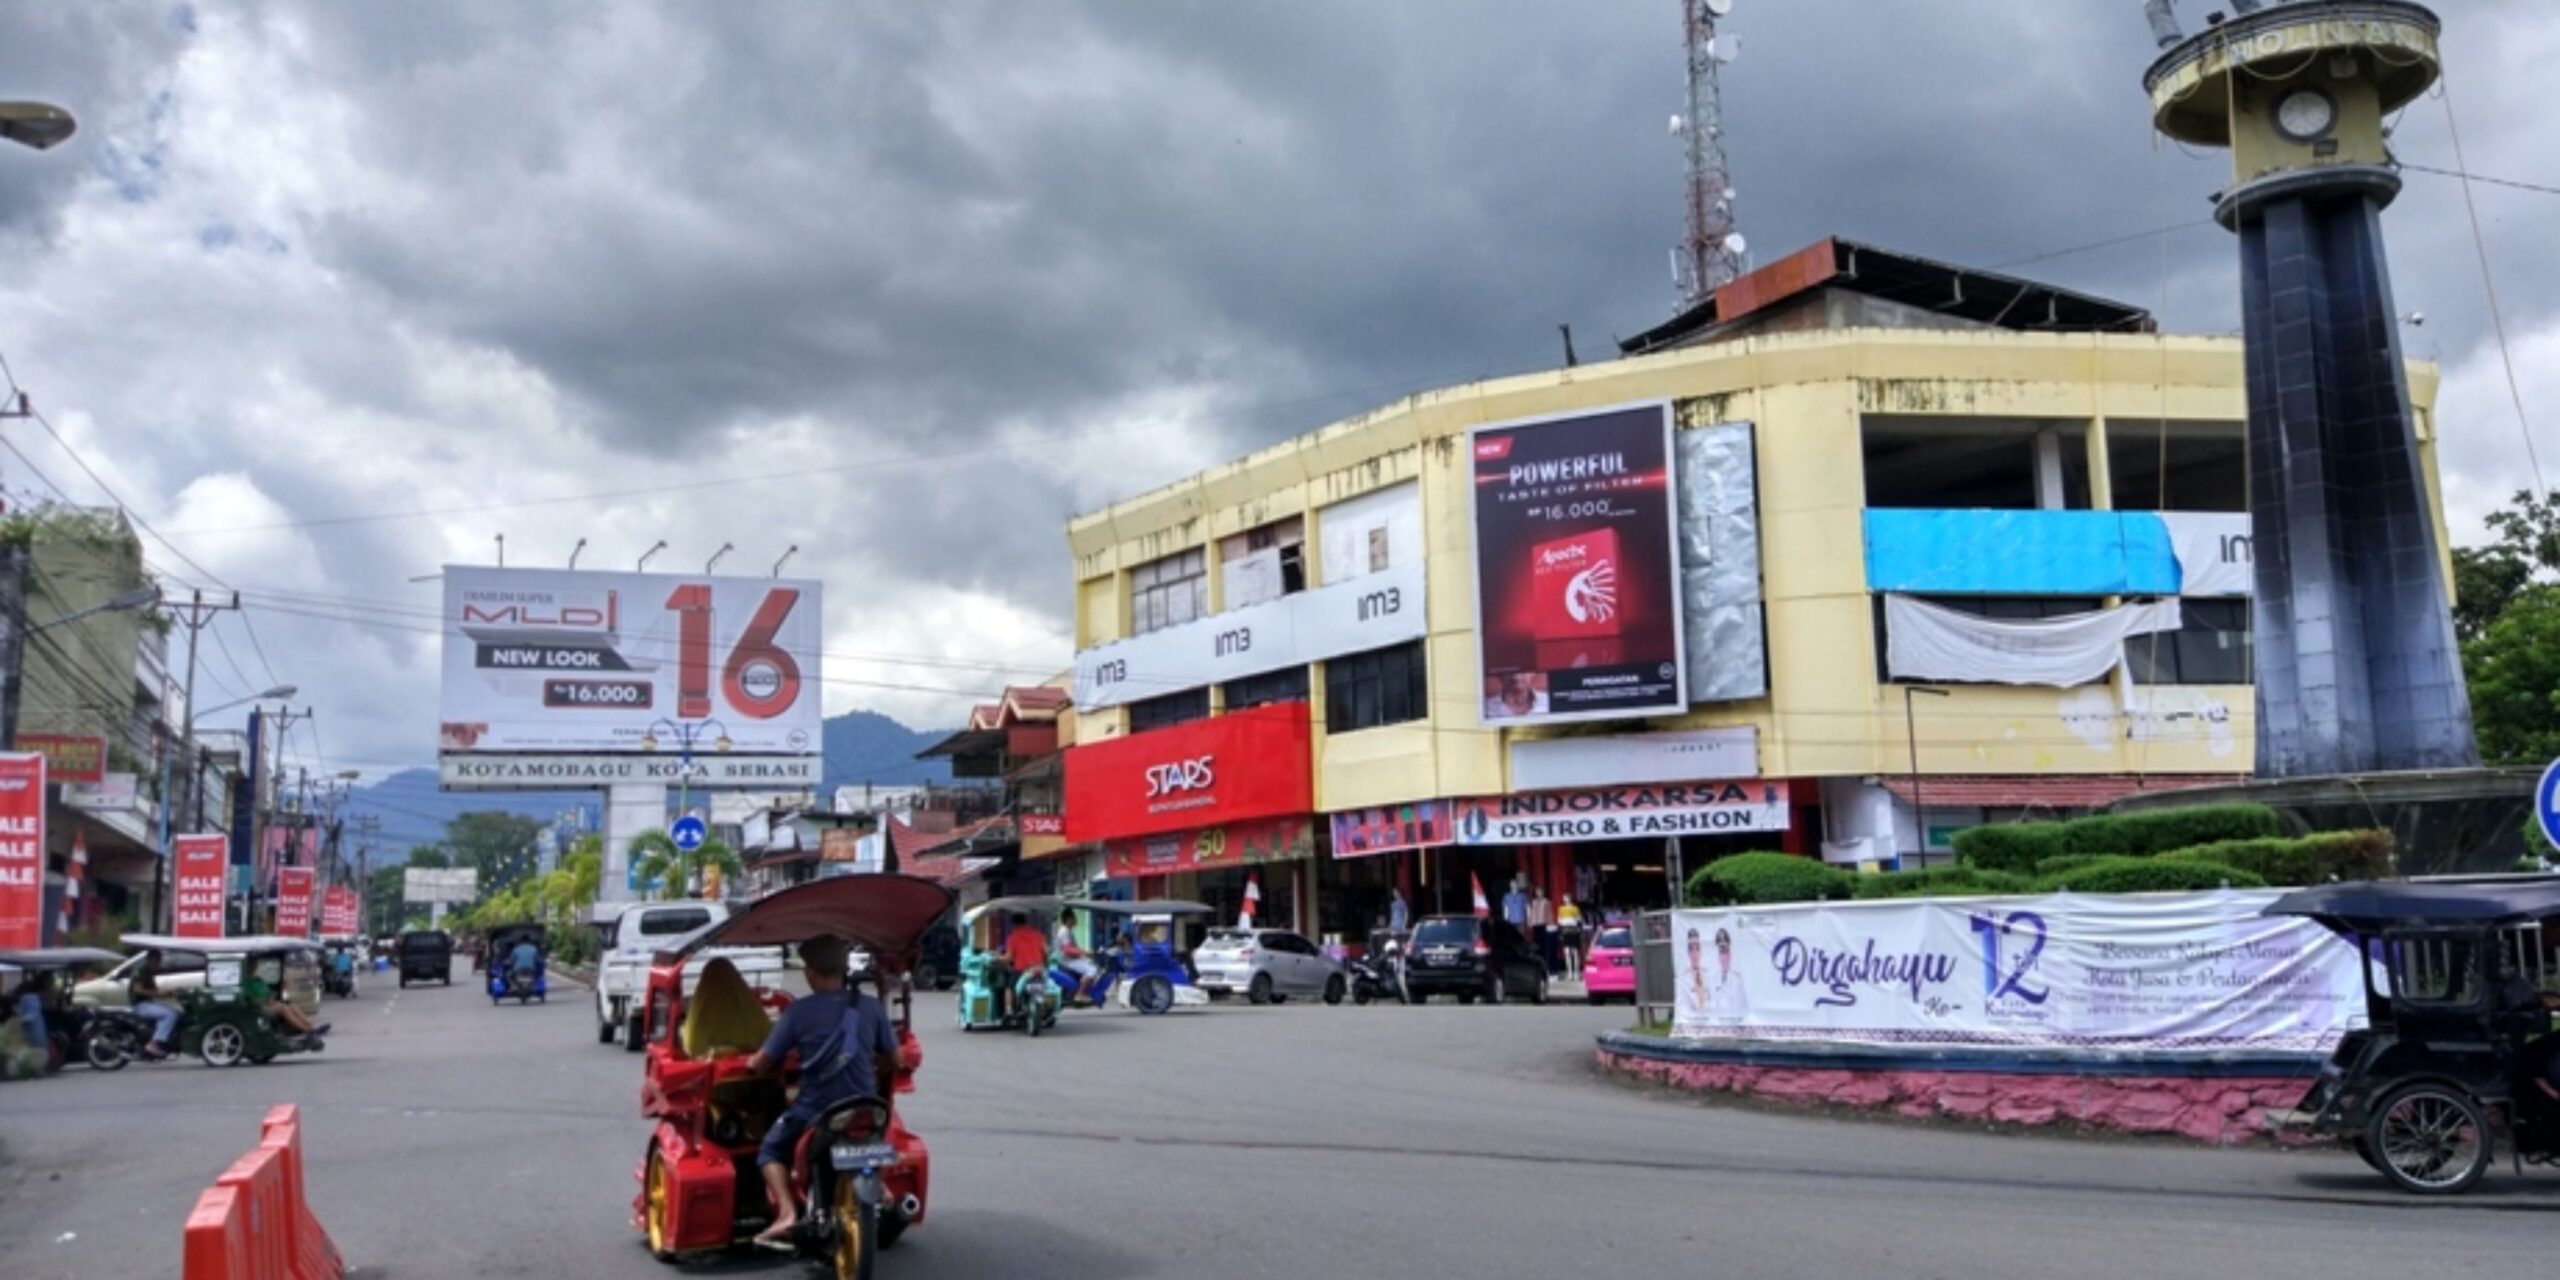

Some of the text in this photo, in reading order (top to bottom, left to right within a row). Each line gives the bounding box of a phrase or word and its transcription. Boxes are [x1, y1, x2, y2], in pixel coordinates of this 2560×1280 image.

[1509, 452, 1628, 487] POWERFUL
[1498, 476, 1642, 501] TASTE OF FILTER
[493, 649, 601, 667] NEW LOOK
[456, 764, 632, 777] KOTAMOBAGU
[725, 764, 810, 777] SERASI
[1145, 754, 1213, 797] STARS
[1500, 782, 1748, 816] INDOKARSA
[0, 817, 37, 835] ALE
[1501, 809, 1752, 839] DISTRO & FASHION
[0, 841, 36, 859] ALE
[0, 867, 35, 885] ALE
[179, 876, 221, 890] SALE
[179, 892, 221, 906] SALE
[179, 910, 220, 924] SALE
[1771, 936, 1956, 1007] Dirgahayu
